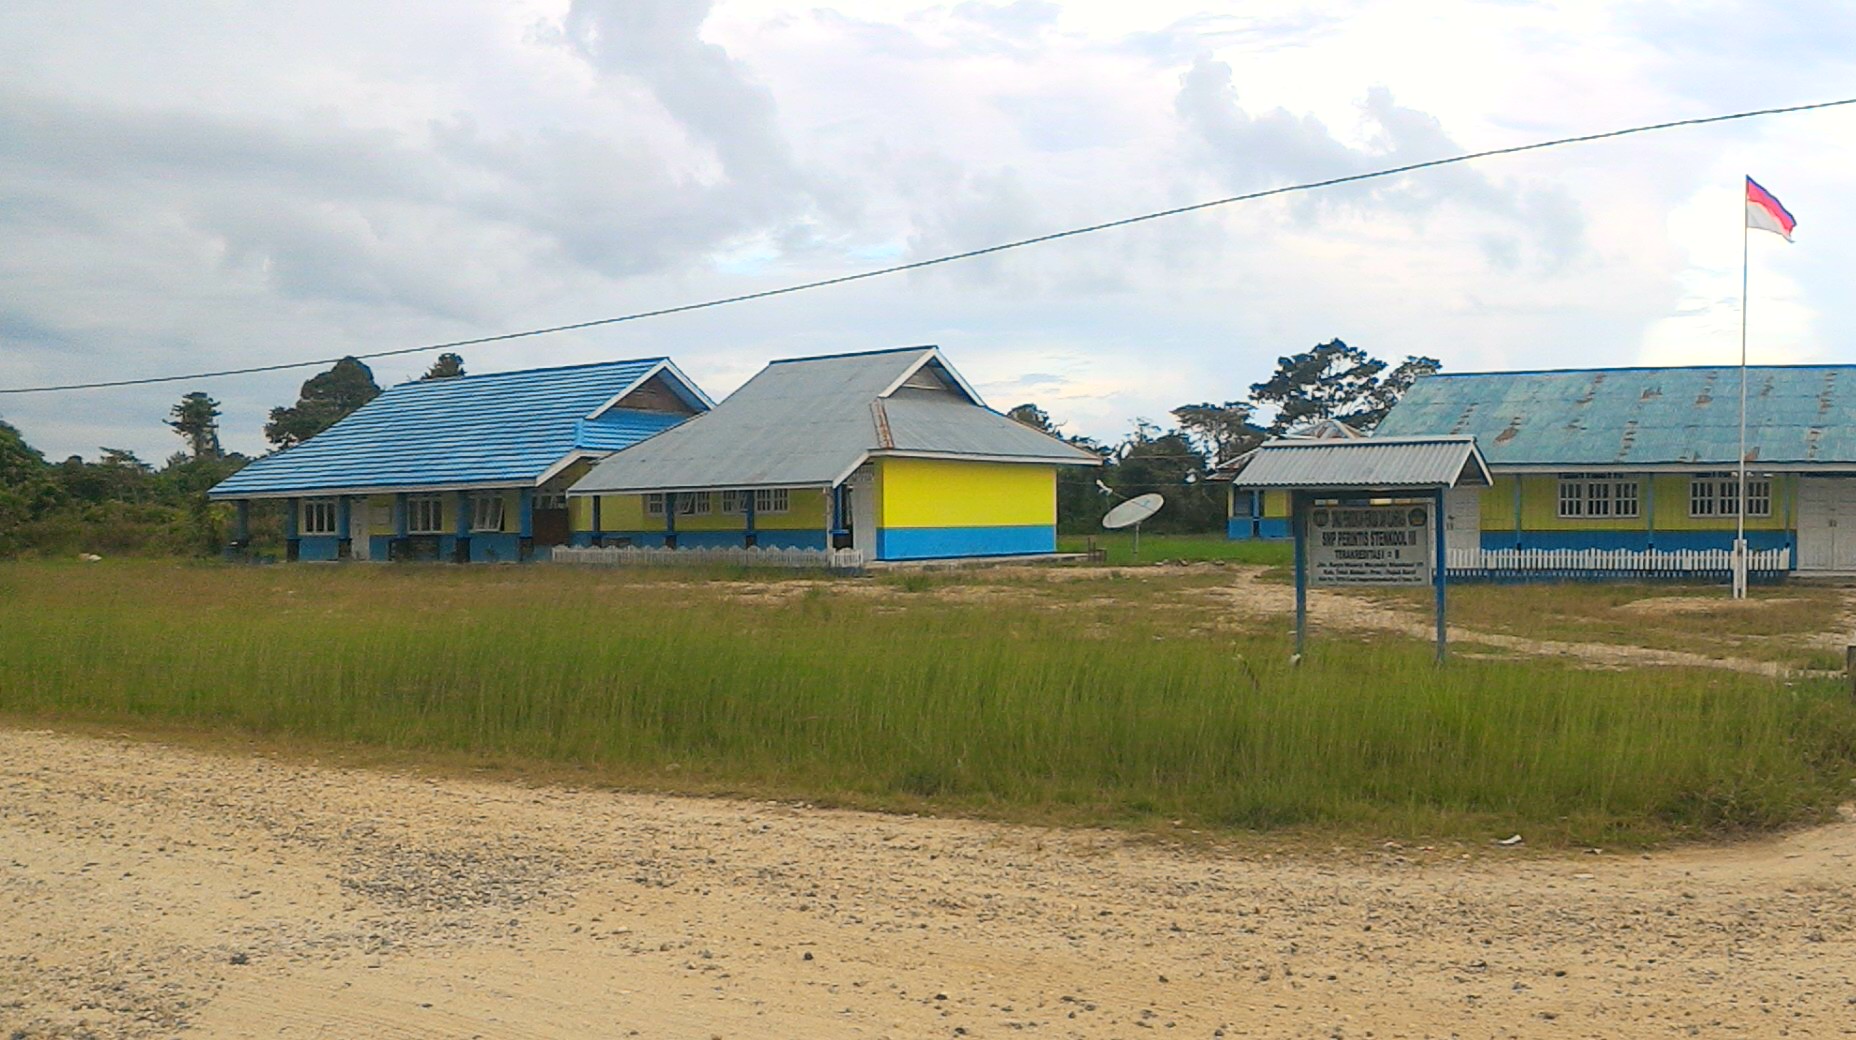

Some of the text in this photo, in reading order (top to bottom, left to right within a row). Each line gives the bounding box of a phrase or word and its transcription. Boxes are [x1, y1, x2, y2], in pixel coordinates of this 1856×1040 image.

[1322, 531, 1336, 546] SMP
[1337, 531, 1368, 546] PERINTIS
[1370, 531, 1407, 546] STENKOOL
[1334, 549, 1384, 559] TERAKREDITASI
